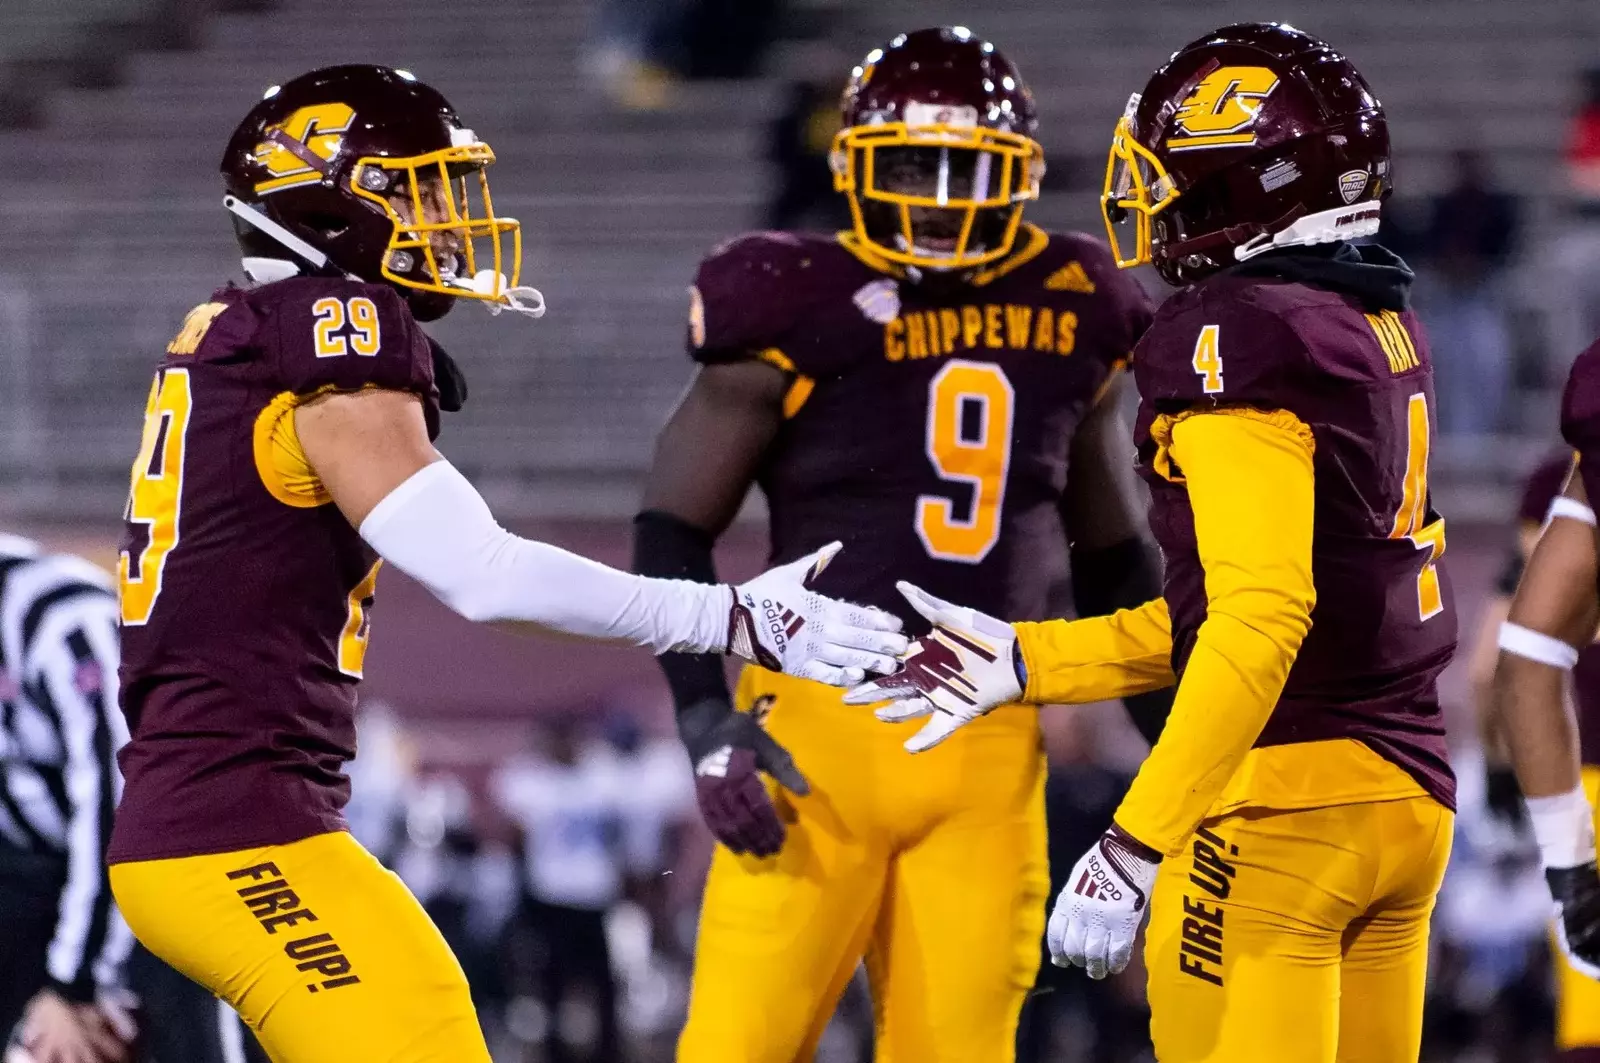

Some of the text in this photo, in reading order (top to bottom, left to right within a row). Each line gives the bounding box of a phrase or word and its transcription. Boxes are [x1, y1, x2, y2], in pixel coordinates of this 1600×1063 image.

[313, 296, 382, 358] 29
[884, 303, 1078, 363] CHIPPEWAS
[1192, 324, 1224, 393] 4
[116, 367, 193, 627] 9
[915, 358, 1015, 565] 9
[1388, 392, 1446, 622] 4
[762, 599, 787, 654] adidas
[225, 861, 361, 993] FIRE UP!
[1088, 855, 1123, 901] adidas
[1179, 826, 1240, 987] FIRE UP!
